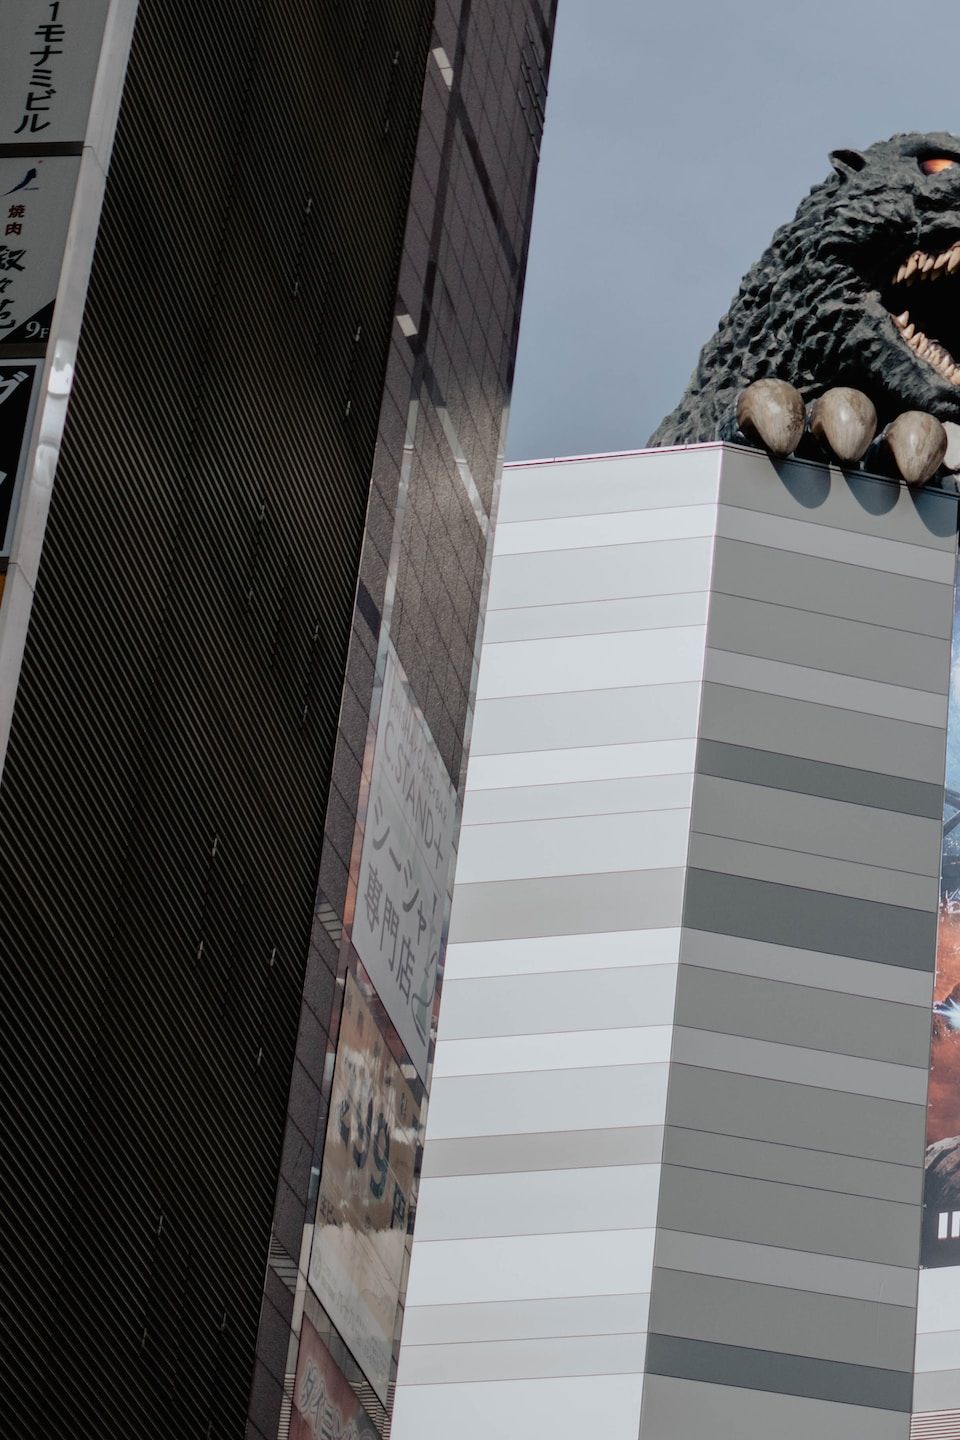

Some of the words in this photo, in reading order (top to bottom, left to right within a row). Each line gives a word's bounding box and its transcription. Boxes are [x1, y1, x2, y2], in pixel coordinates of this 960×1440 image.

[5, 204, 26, 236] 焼肉
[24, 320, 49, 339] 9F
[372, 796, 427, 945] シーシャ
[364, 862, 415, 1006] 専門店
